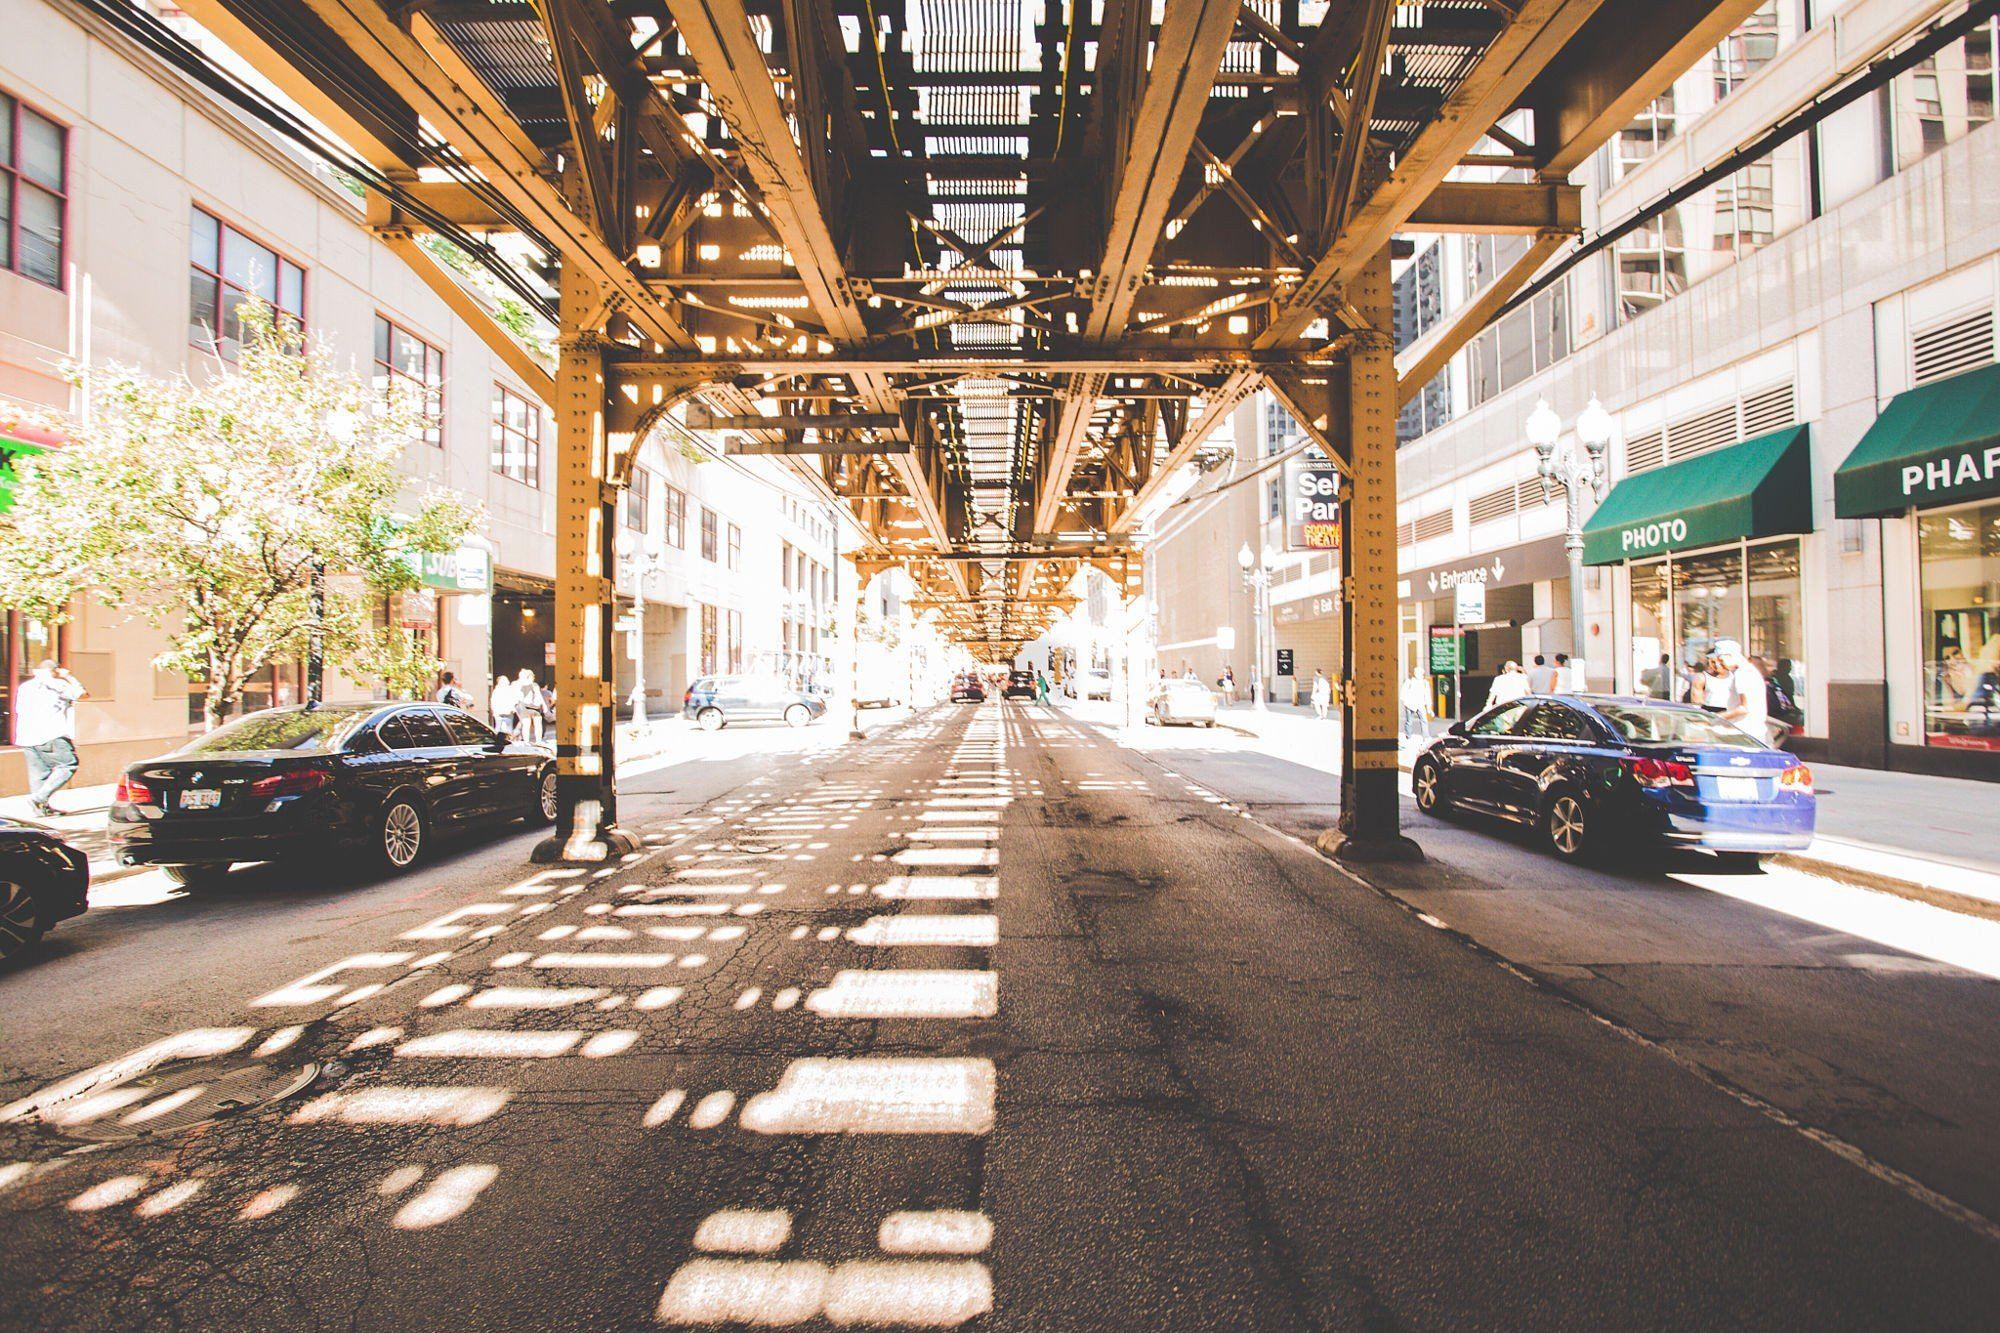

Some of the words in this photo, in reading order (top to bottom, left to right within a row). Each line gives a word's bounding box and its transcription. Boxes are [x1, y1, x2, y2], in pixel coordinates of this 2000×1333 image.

[1299, 472, 1339, 496] Sel
[1295, 498, 1339, 520] Par
[1621, 518, 1687, 551] PHOTO
[426, 552, 457, 577] SUB
[1440, 567, 1487, 590] Entrance
